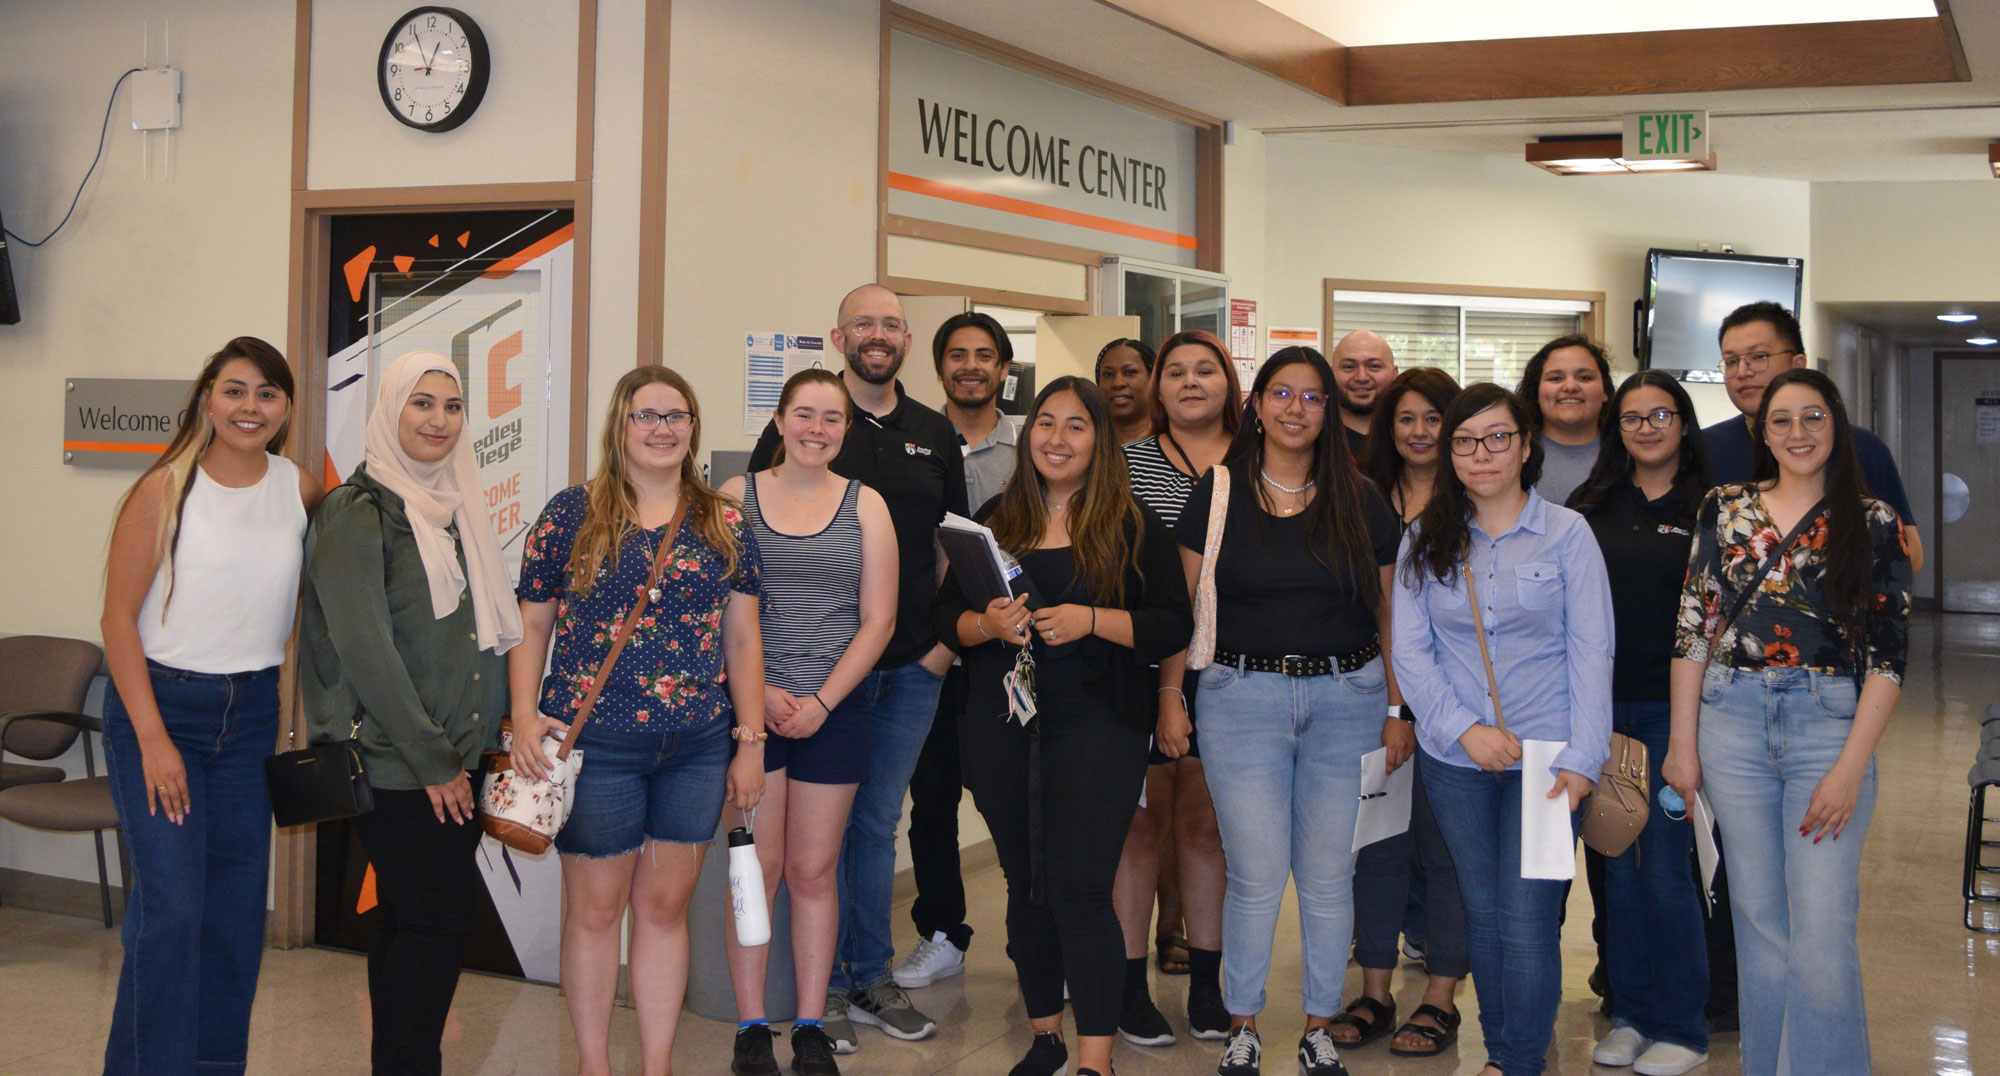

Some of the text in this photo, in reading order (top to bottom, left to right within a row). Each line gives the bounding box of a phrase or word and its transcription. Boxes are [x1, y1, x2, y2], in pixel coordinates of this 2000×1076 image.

[427, 16, 437, 28] 12
[409, 24, 417, 36] 11
[394, 42, 404, 54] 10
[460, 36, 467, 48] 2
[390, 64, 398, 77] 9
[463, 60, 470, 73] 3
[394, 88, 402, 101] 8
[456, 82, 464, 95] 4
[408, 105, 415, 117] 7
[444, 102, 451, 114] 5
[425, 109, 433, 121] 6
[1639, 114, 1693, 154] EXIT
[918, 98, 1167, 211] WELCOME CENTER
[79, 405, 171, 432] Welcome
[473, 417, 522, 453] edley
